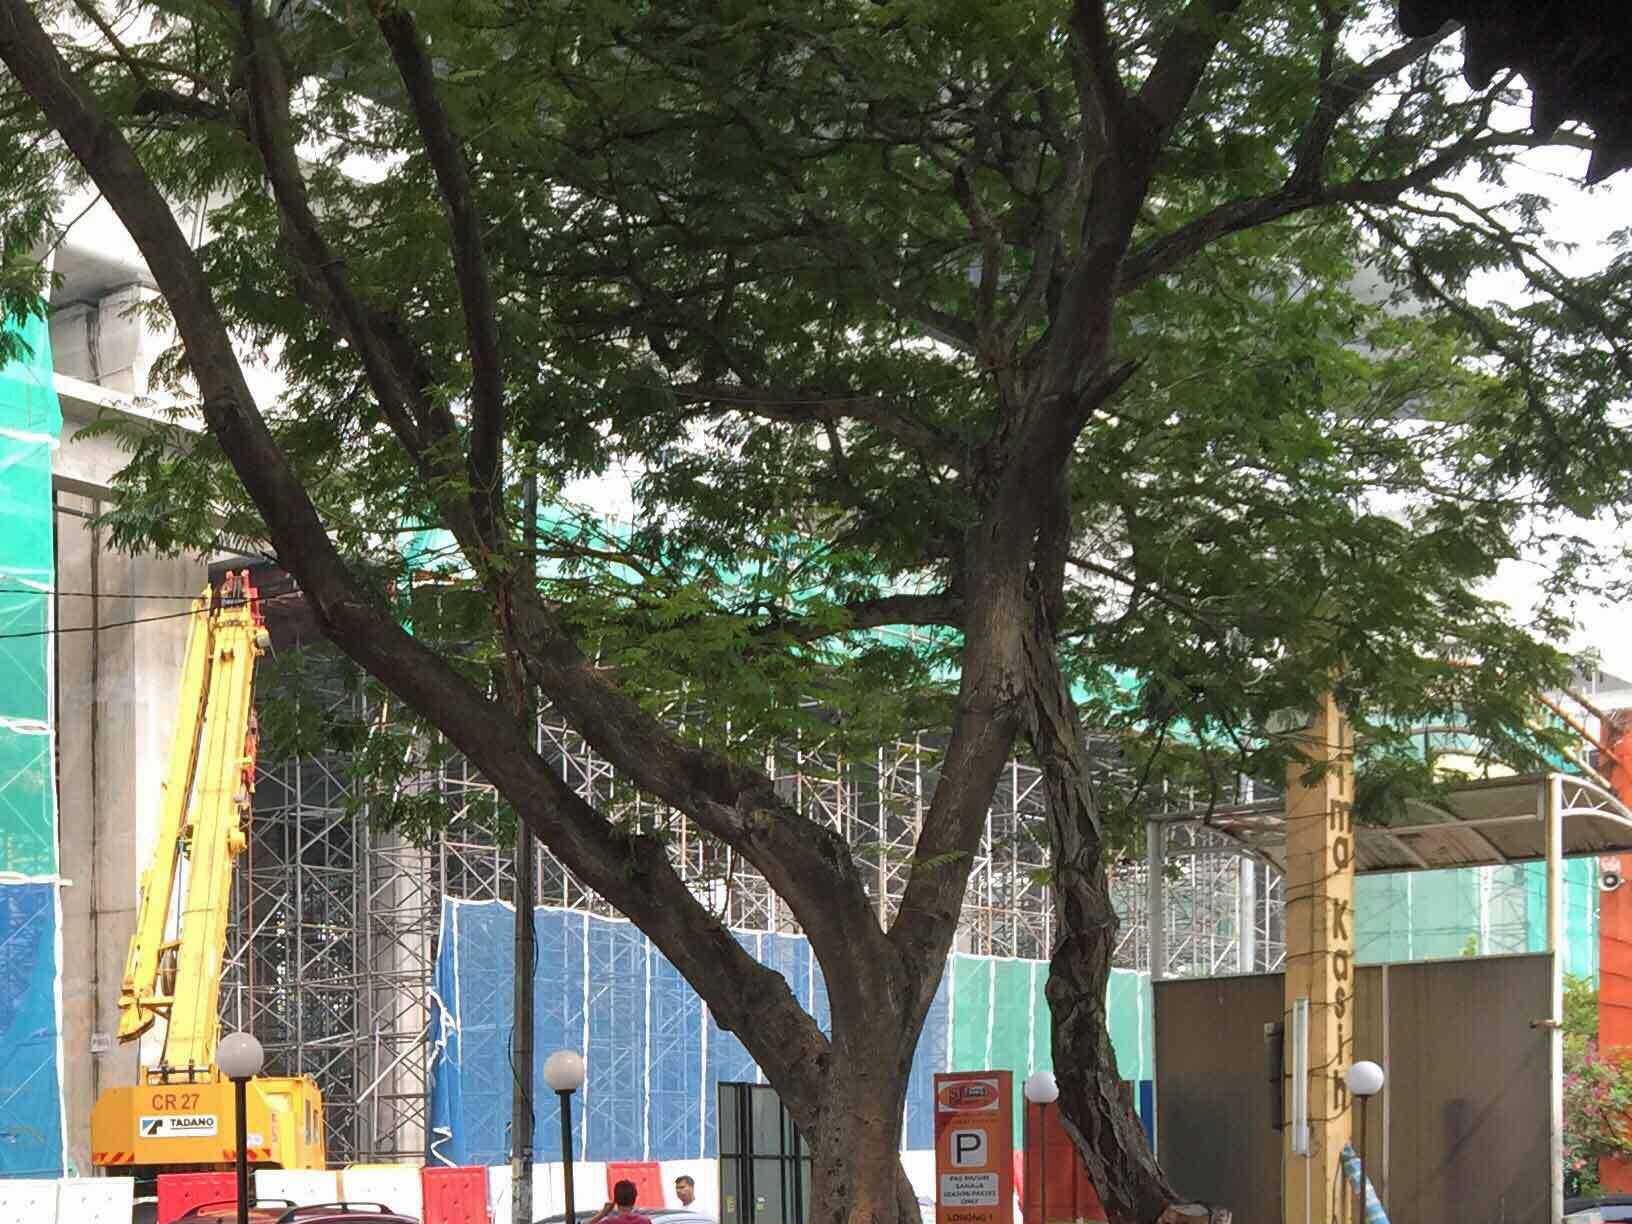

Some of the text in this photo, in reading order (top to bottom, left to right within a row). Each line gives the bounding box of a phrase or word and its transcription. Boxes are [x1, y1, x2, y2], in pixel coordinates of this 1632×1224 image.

[152, 1093, 200, 1111] CR 27
[171, 1118, 214, 1126] TADANO
[957, 1133, 981, 1164] P
